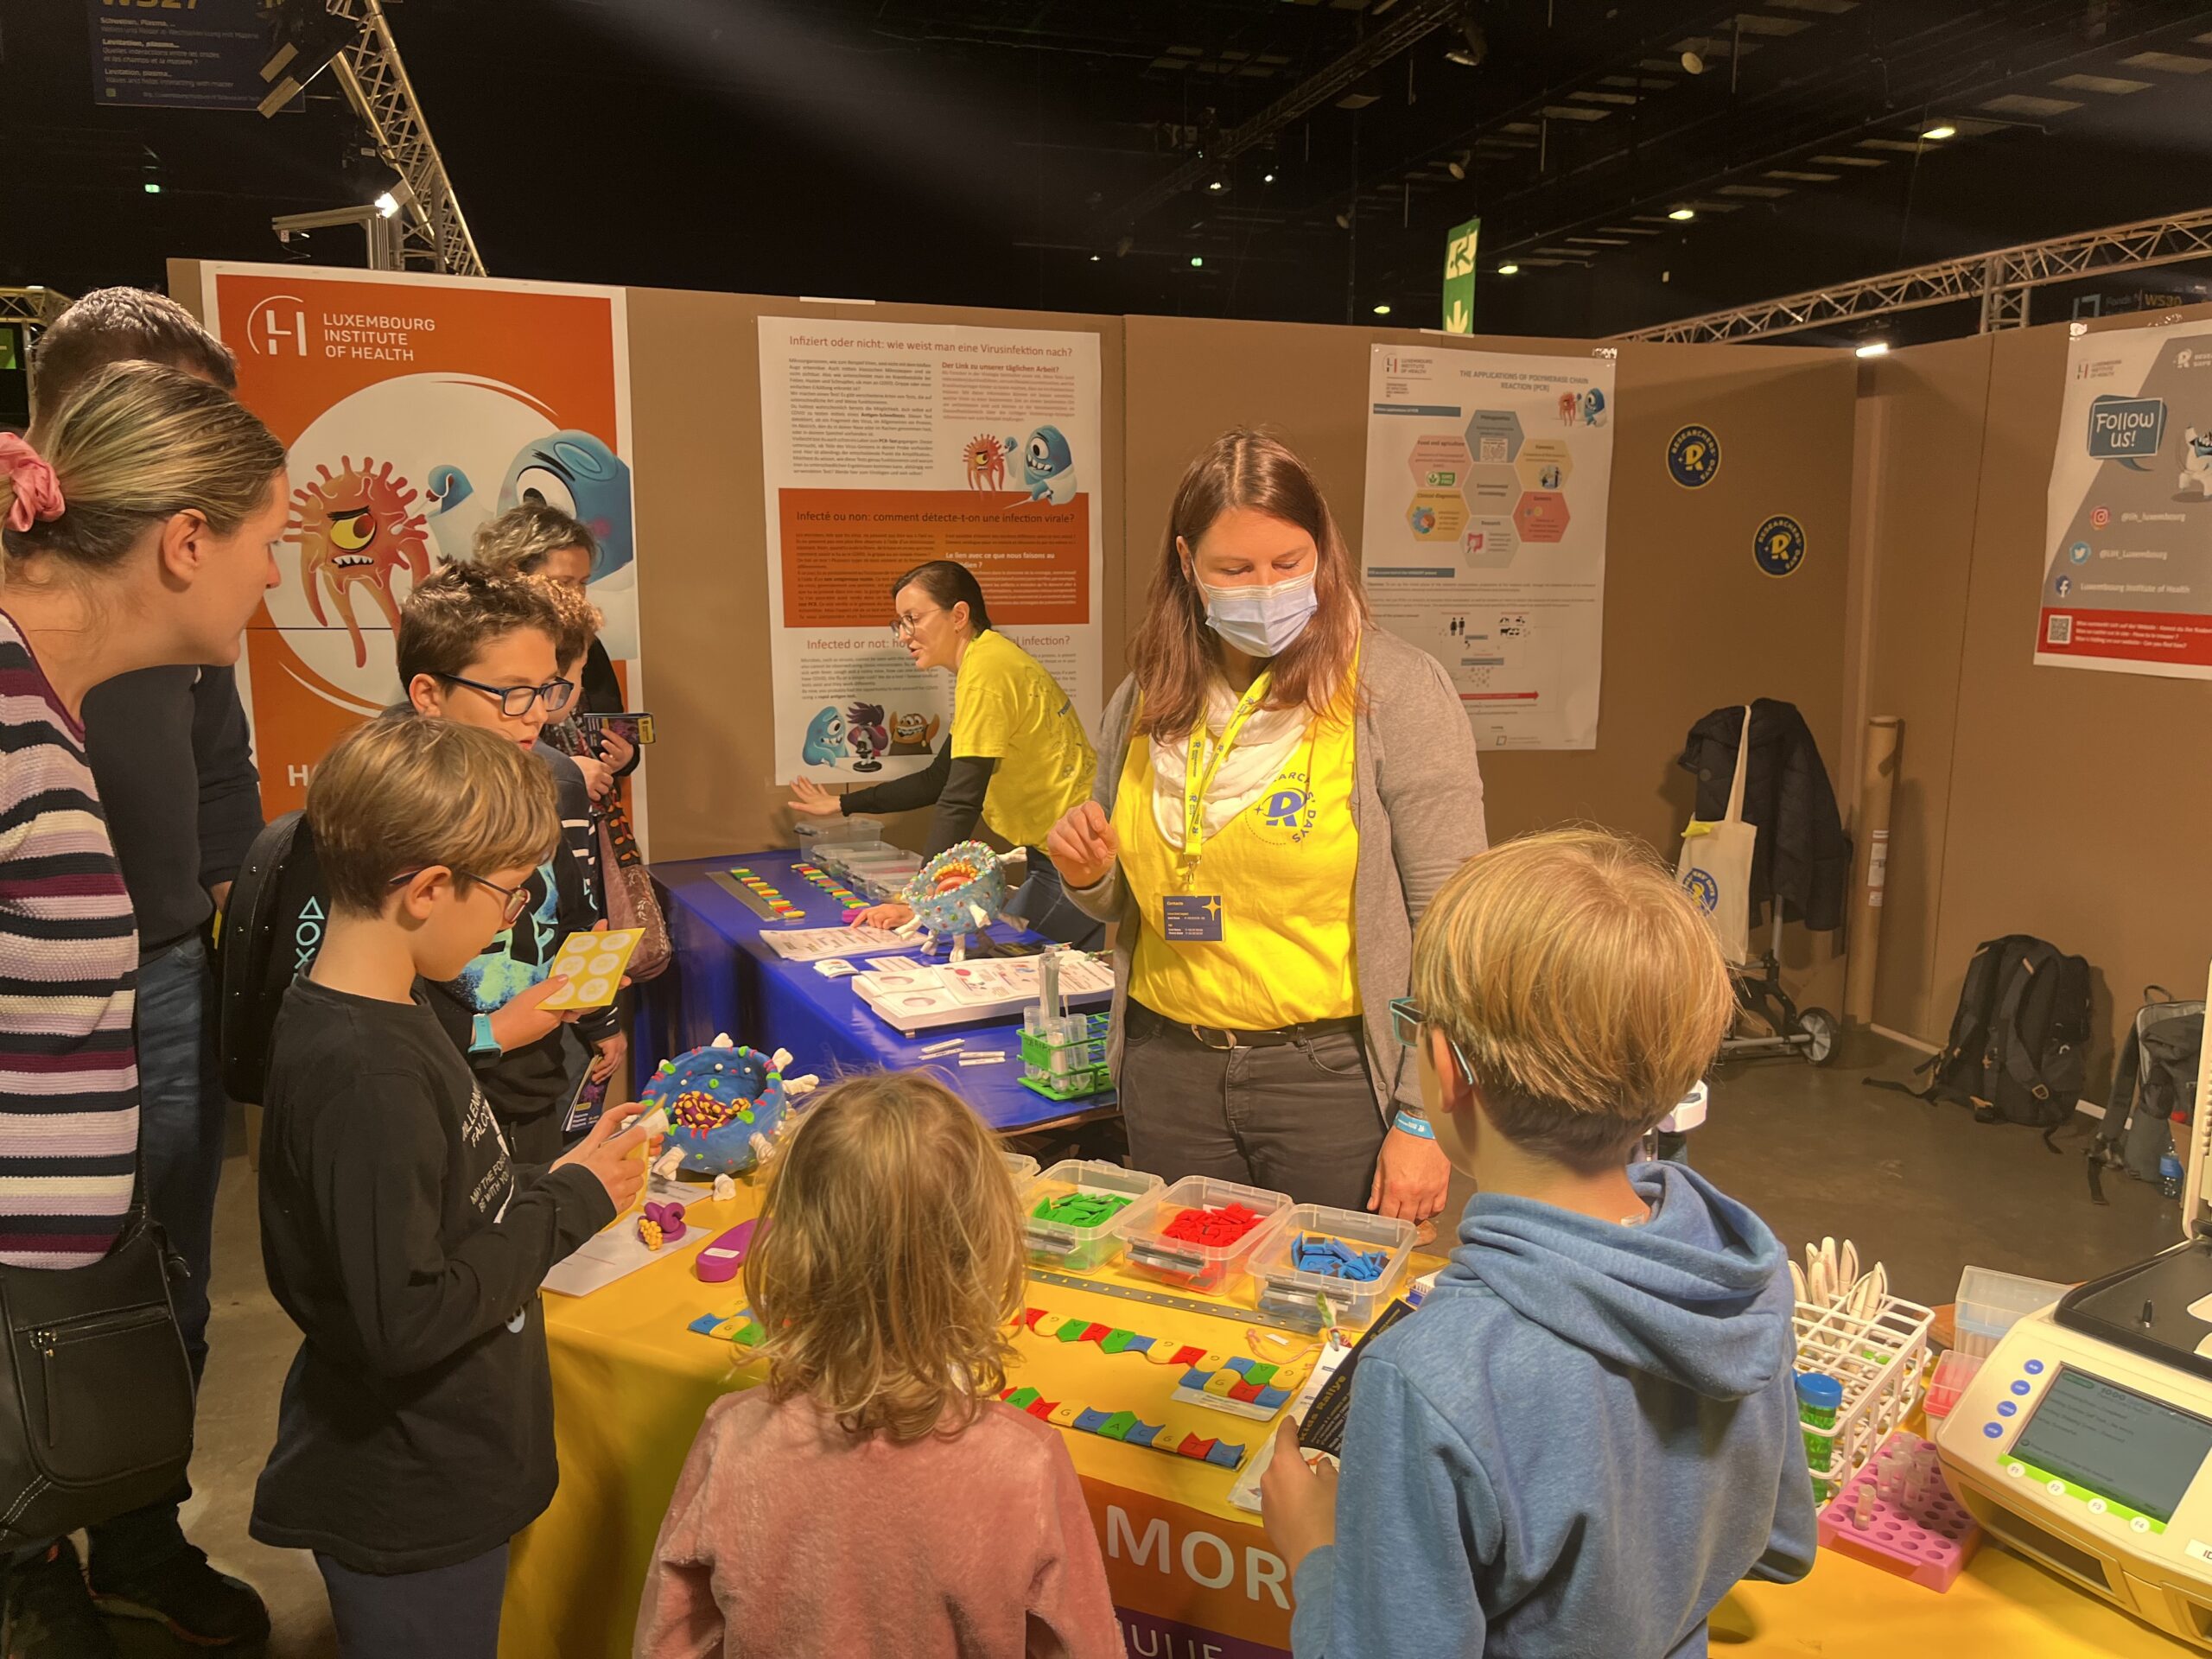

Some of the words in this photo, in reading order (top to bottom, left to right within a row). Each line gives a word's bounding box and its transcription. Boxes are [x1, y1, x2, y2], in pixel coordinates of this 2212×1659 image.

[323, 313, 435, 332] LUXEMBOURG
[324, 329, 408, 346] INSTITUTE
[325, 345, 346, 359] OF
[352, 346, 414, 361] HEALTH
[790, 335, 828, 346] Infiziert
[830, 338, 854, 347] oder
[856, 339, 884, 349] nicht:
[887, 340, 904, 350] wie
[906, 340, 932, 351] weist
[935, 343, 956, 352] man
[958, 343, 978, 353] eine
[980, 344, 1044, 356] Virusinfektion
[1046, 346, 1073, 357] nach?
[1474, 372, 1517, 380] APPLICATIONS
[1529, 374, 1568, 384] POLYMERASE
[1501, 382, 1531, 391] REACTION
[2096, 412, 2155, 433] Follow
[2110, 431, 2136, 448] us!
[1700, 459, 1715, 480] DAYS
[797, 511, 831, 521] Infecté
[849, 513, 871, 522] non:
[874, 513, 919, 522] comment
[922, 512, 980, 523] détecte-t-on
[983, 514, 1001, 523] une
[1002, 512, 1041, 524] infection
[1045, 513, 1075, 524] virale?
[807, 639, 850, 650] Infected
[868, 639, 890, 648] not:
[1022, 636, 1070, 646] infection?
[1292, 809, 1317, 843] DAYS
[480, 1169, 495, 1190] THE
[2011, 1465, 2018, 1474] F1
[2050, 1483, 2060, 1491] F2
[2092, 1501, 2102, 1510] F3
[2134, 1521, 2145, 1529] F4
[1107, 1504, 1291, 1611] MOR
